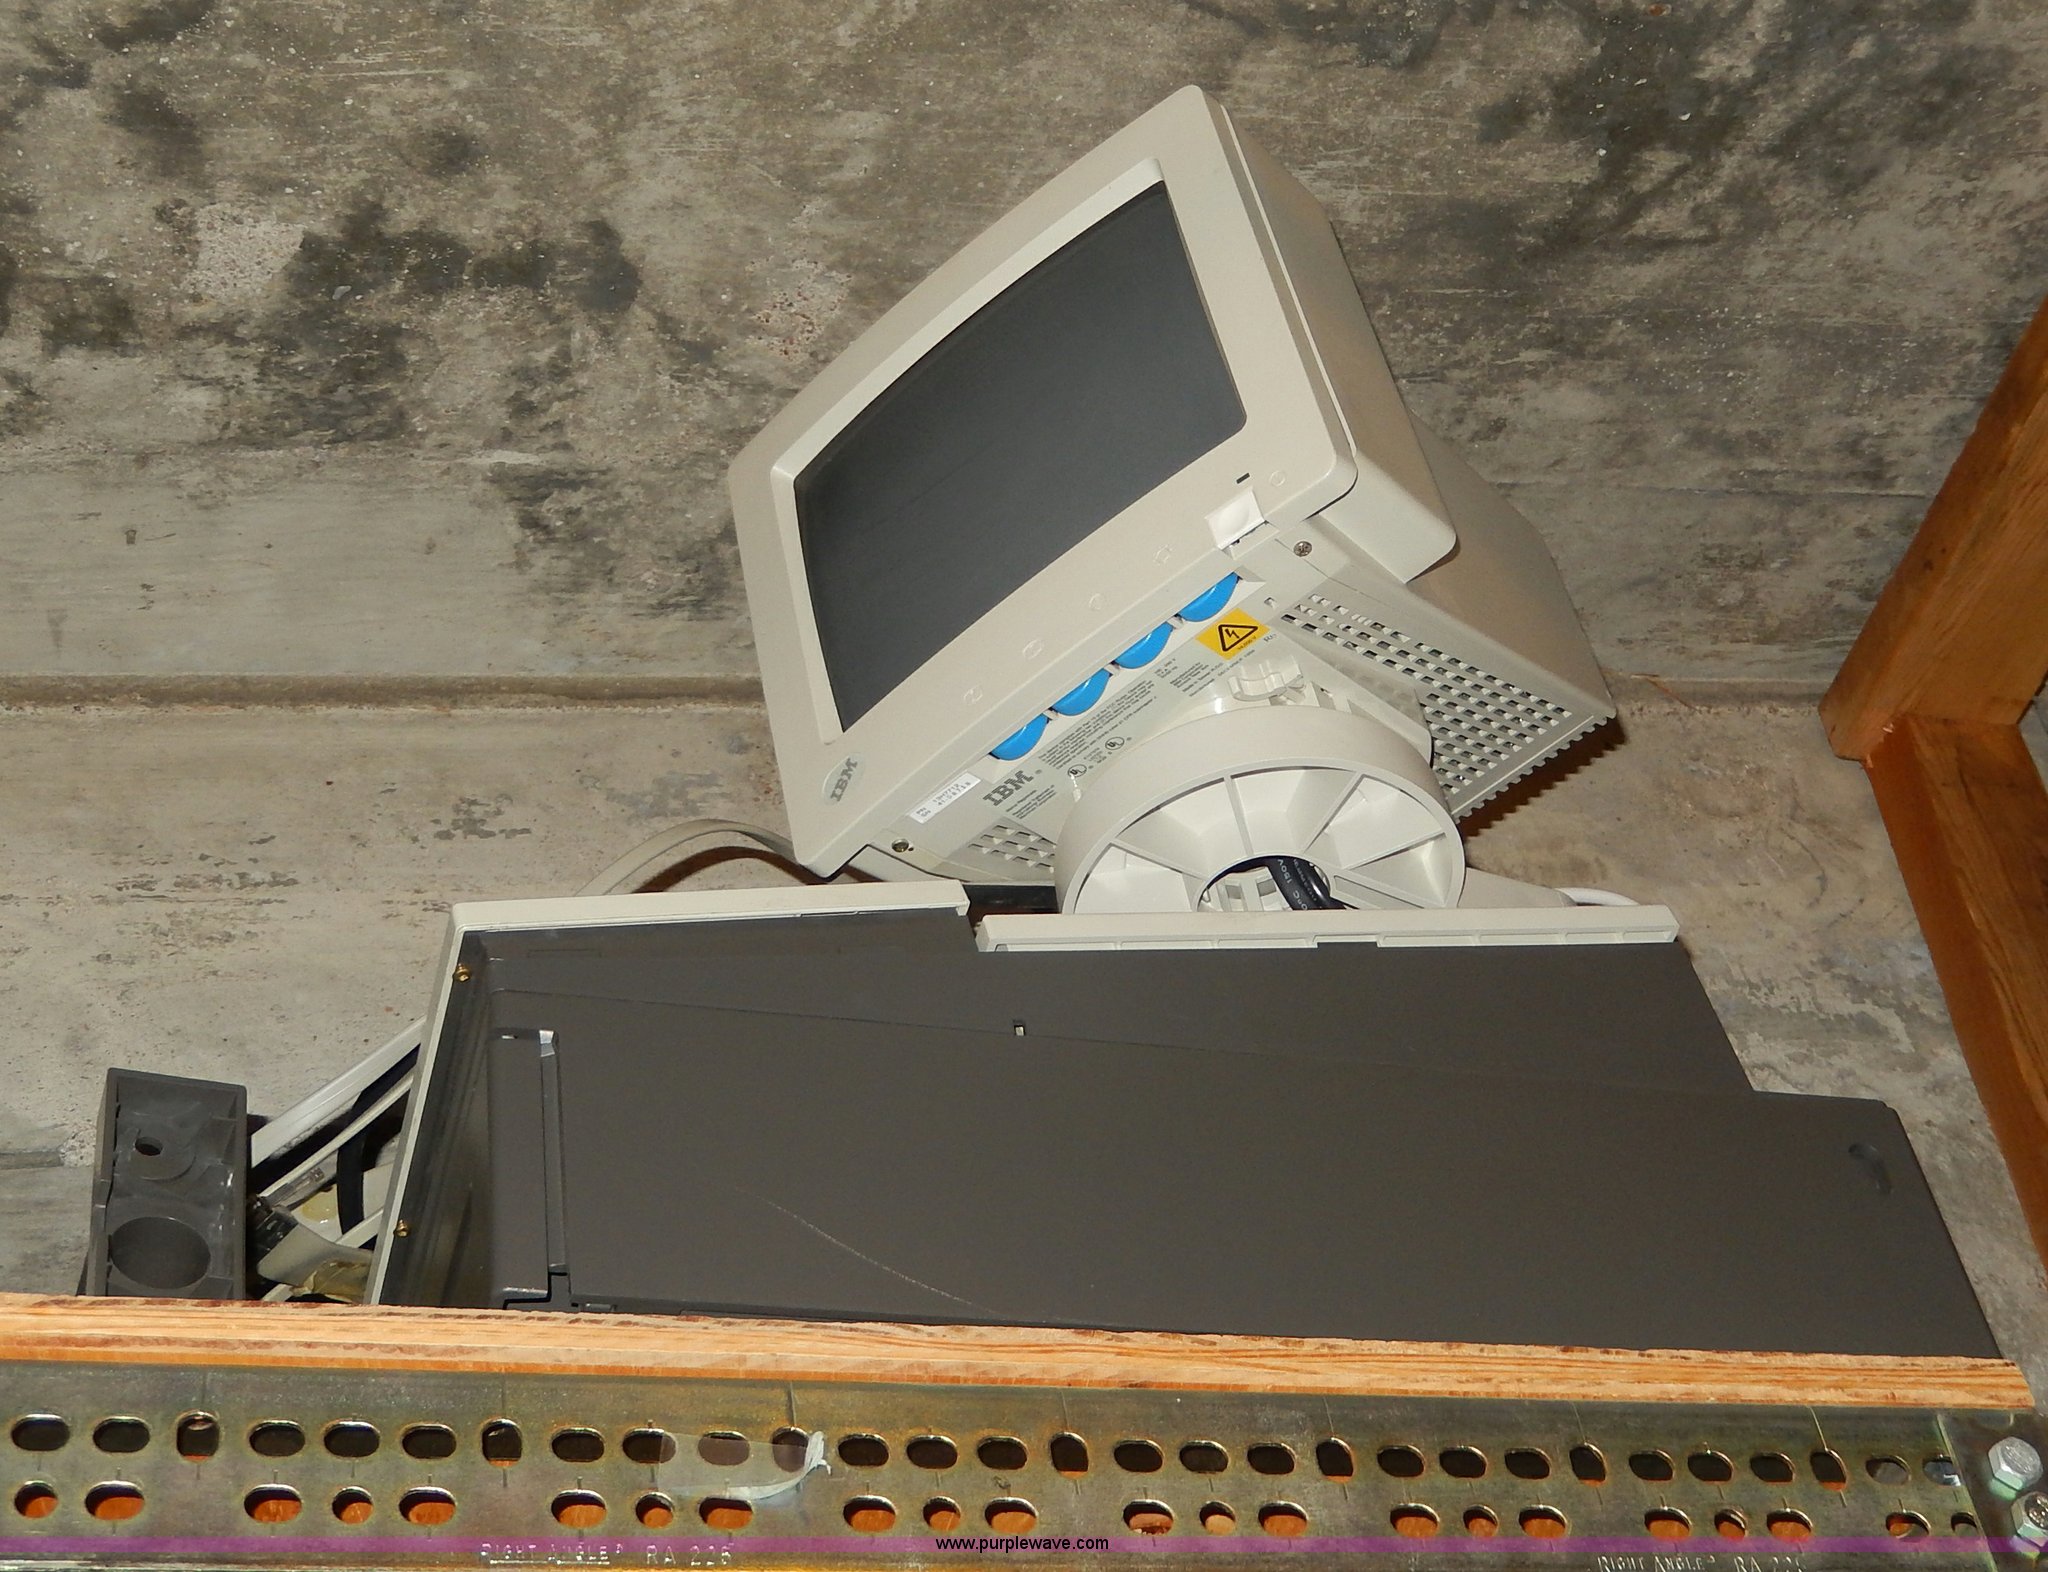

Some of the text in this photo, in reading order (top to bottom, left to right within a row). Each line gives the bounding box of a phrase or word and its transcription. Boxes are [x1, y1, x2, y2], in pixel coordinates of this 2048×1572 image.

[830, 757, 858, 802] IBM
[982, 770, 1034, 806] IBM
[646, 1545, 677, 1565] RA
[1597, 1555, 1644, 1572] RIGHT
[1733, 1555, 1762, 1572] RA
